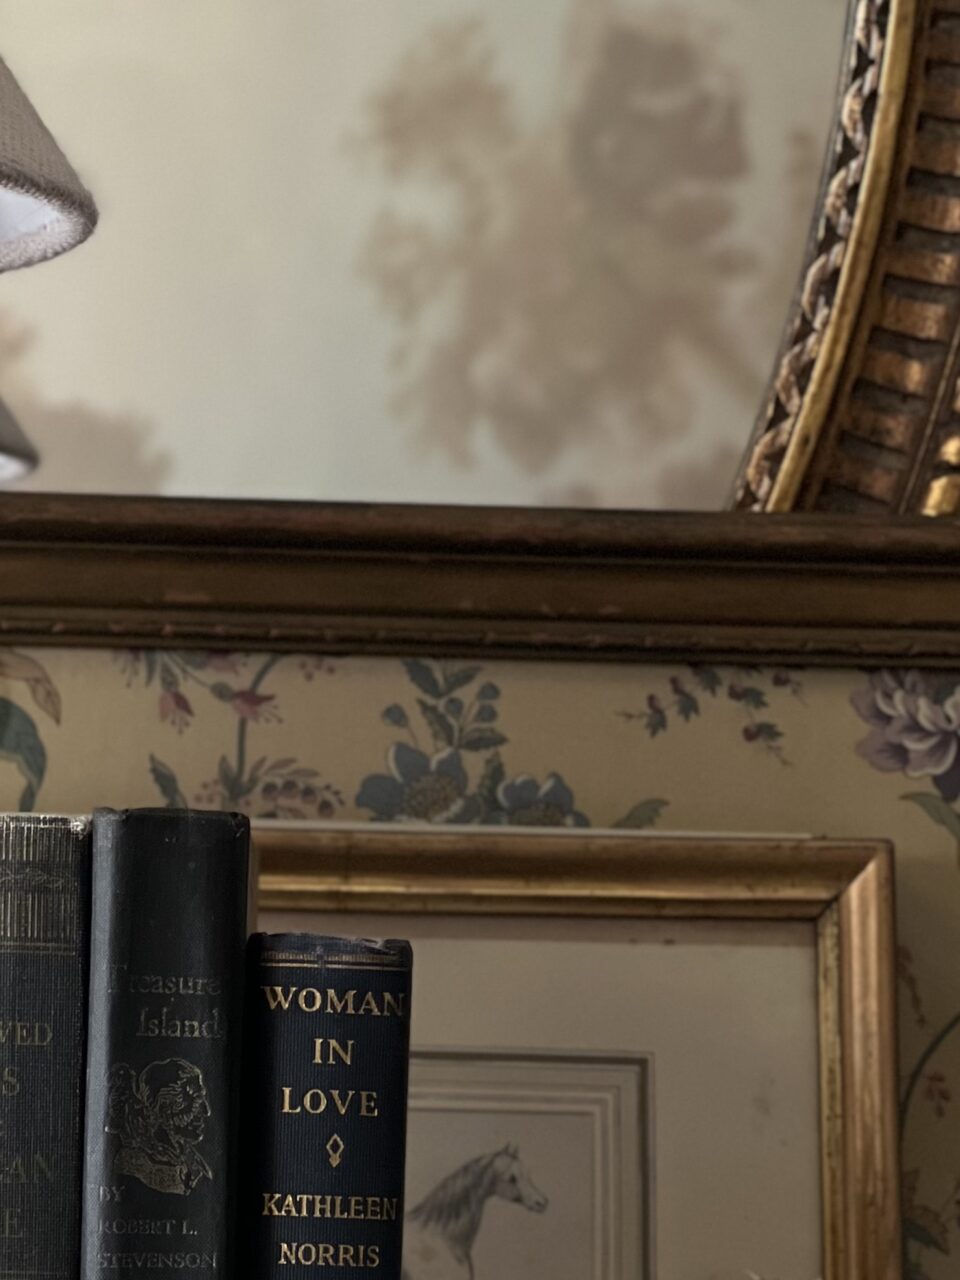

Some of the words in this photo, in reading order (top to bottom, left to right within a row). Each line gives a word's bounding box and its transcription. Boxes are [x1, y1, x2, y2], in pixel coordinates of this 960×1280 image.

[260, 985, 405, 1017] WOMAN
[136, 1006, 223, 1038] Island
[312, 1038, 355, 1066] IN
[281, 1087, 379, 1117] LOVE
[262, 1193, 398, 1221] KATHLEEN
[95, 1251, 218, 1269] STEVENSON
[278, 1243, 380, 1268] NORRIS
